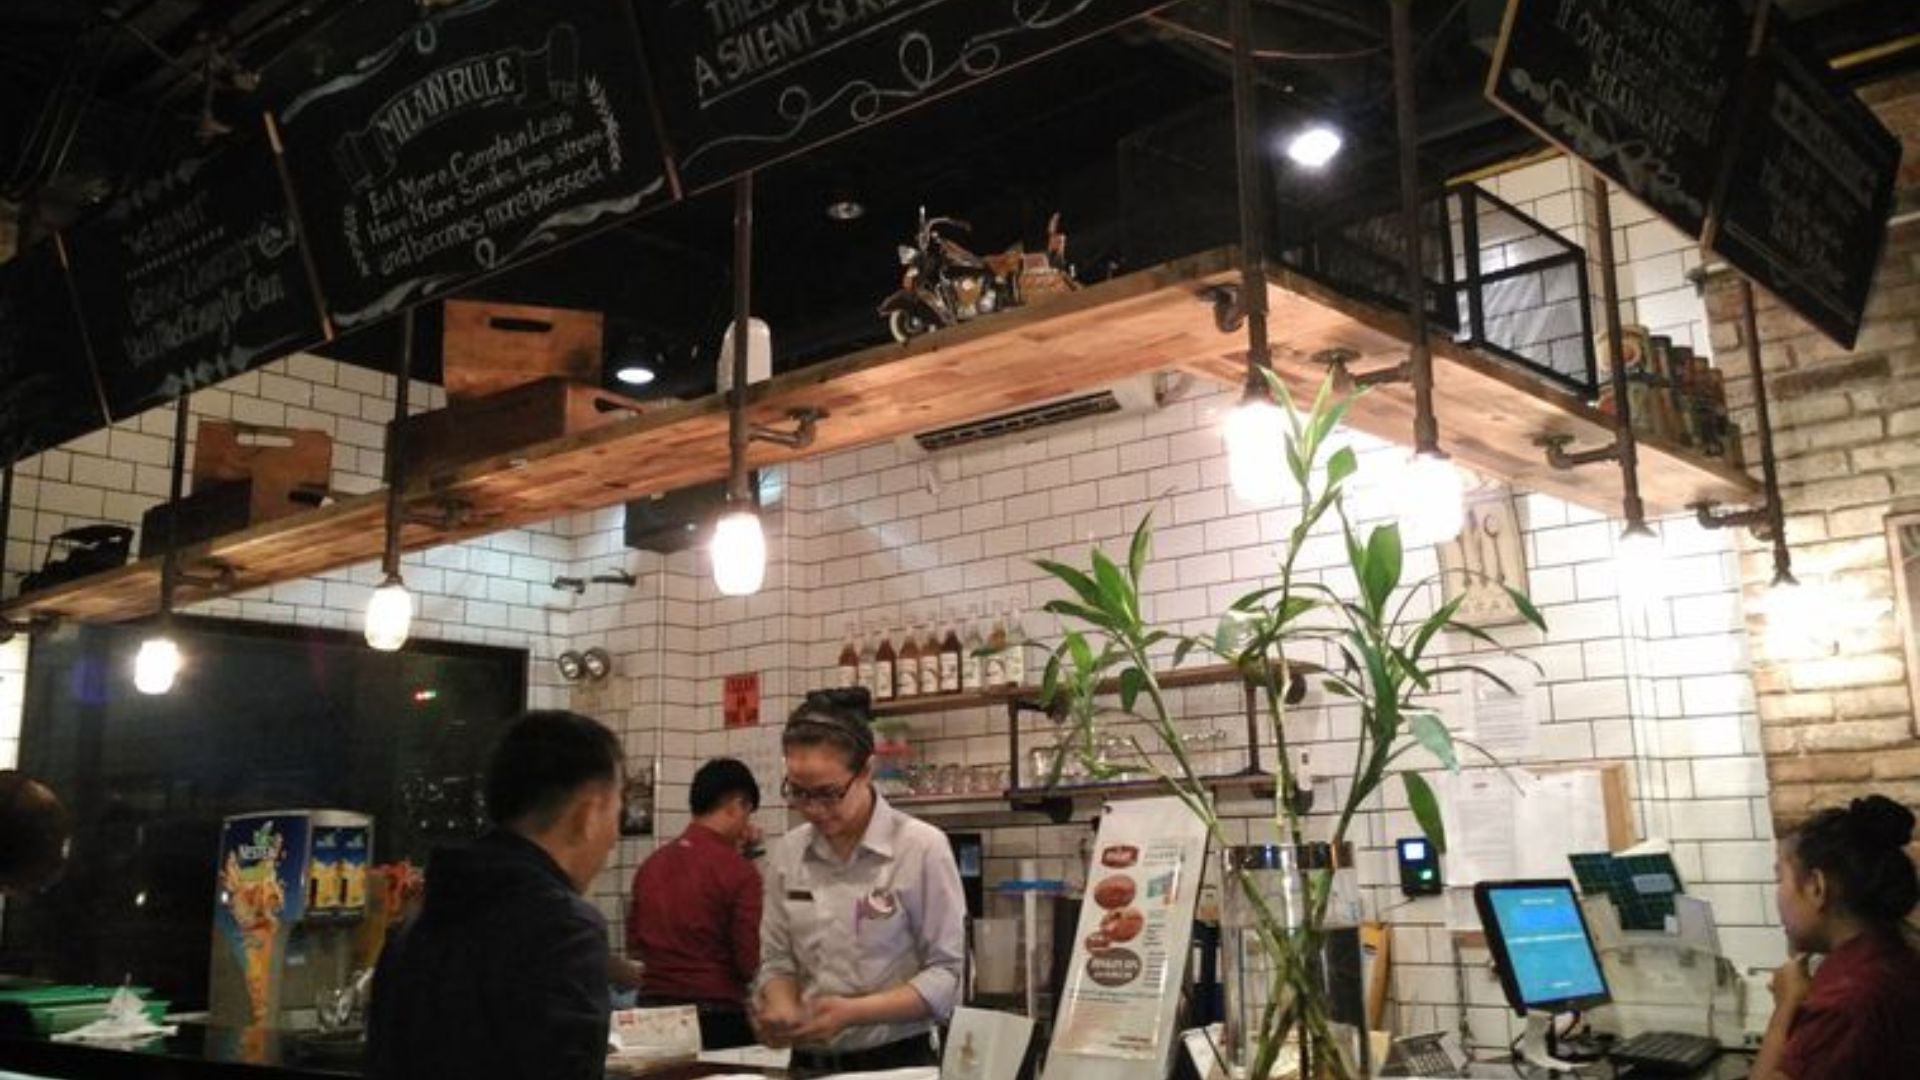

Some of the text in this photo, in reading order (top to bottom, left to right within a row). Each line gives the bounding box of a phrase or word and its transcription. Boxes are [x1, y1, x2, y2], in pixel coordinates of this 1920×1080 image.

[695, 54, 721, 100] A
[717, 3, 814, 80] SILENT
[397, 169, 449, 204] More
[408, 196, 456, 226] More
